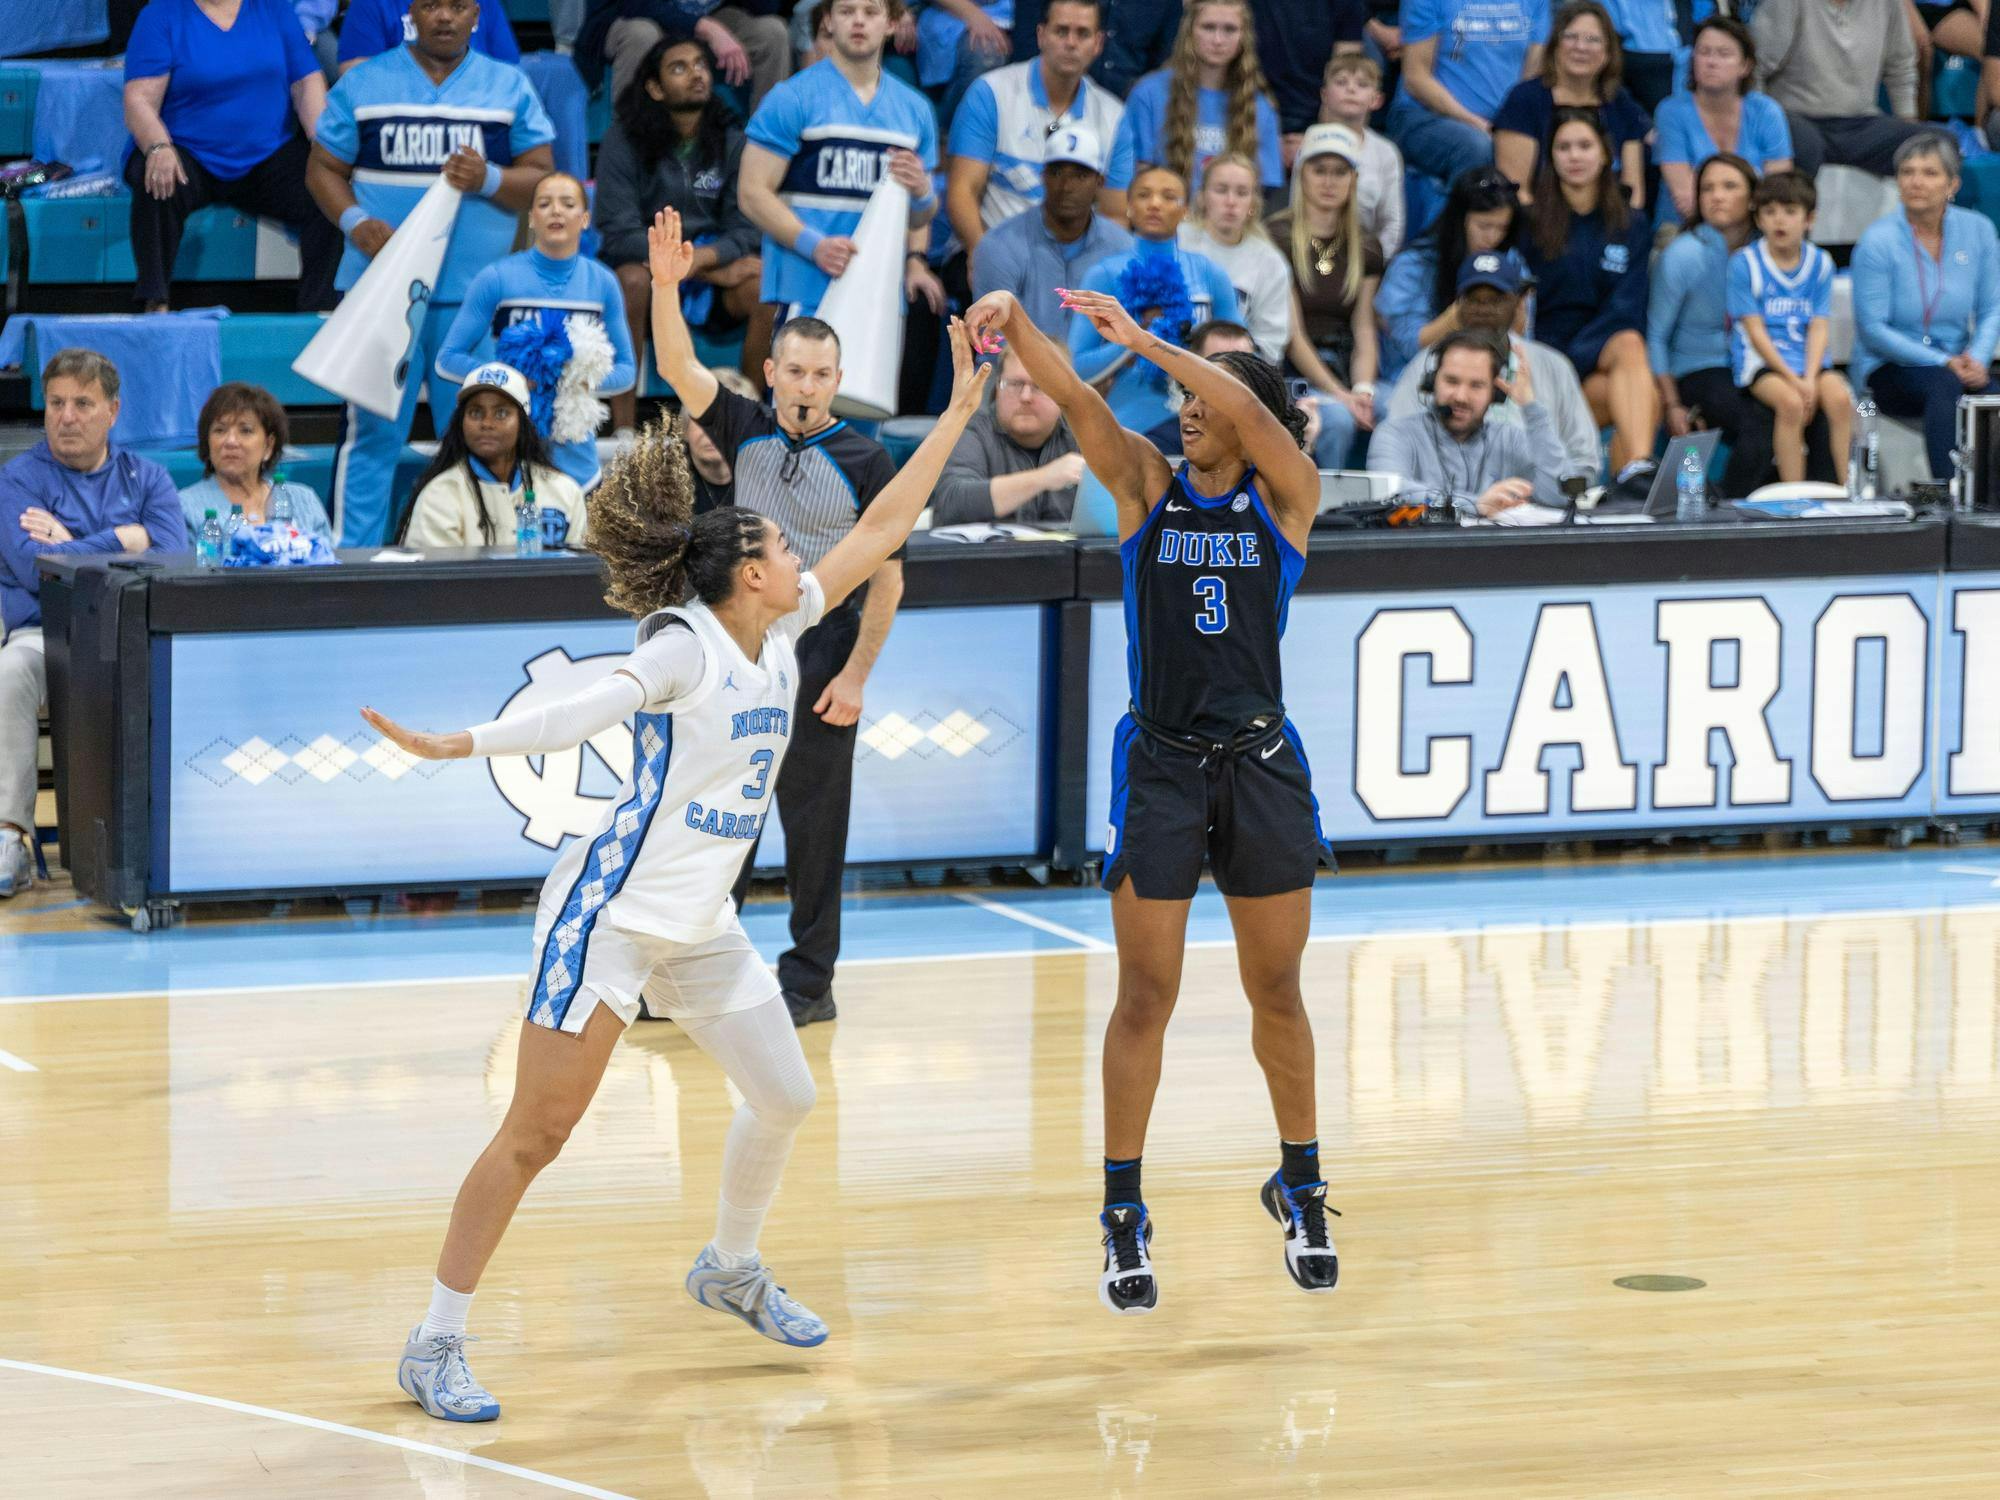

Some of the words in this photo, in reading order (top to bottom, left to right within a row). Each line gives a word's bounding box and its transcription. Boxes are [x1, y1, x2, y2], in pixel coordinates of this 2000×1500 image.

[1157, 528, 1261, 567] DUKE
[1193, 576, 1229, 634] 3
[730, 707, 788, 740] NORTH
[741, 749, 774, 799] 3
